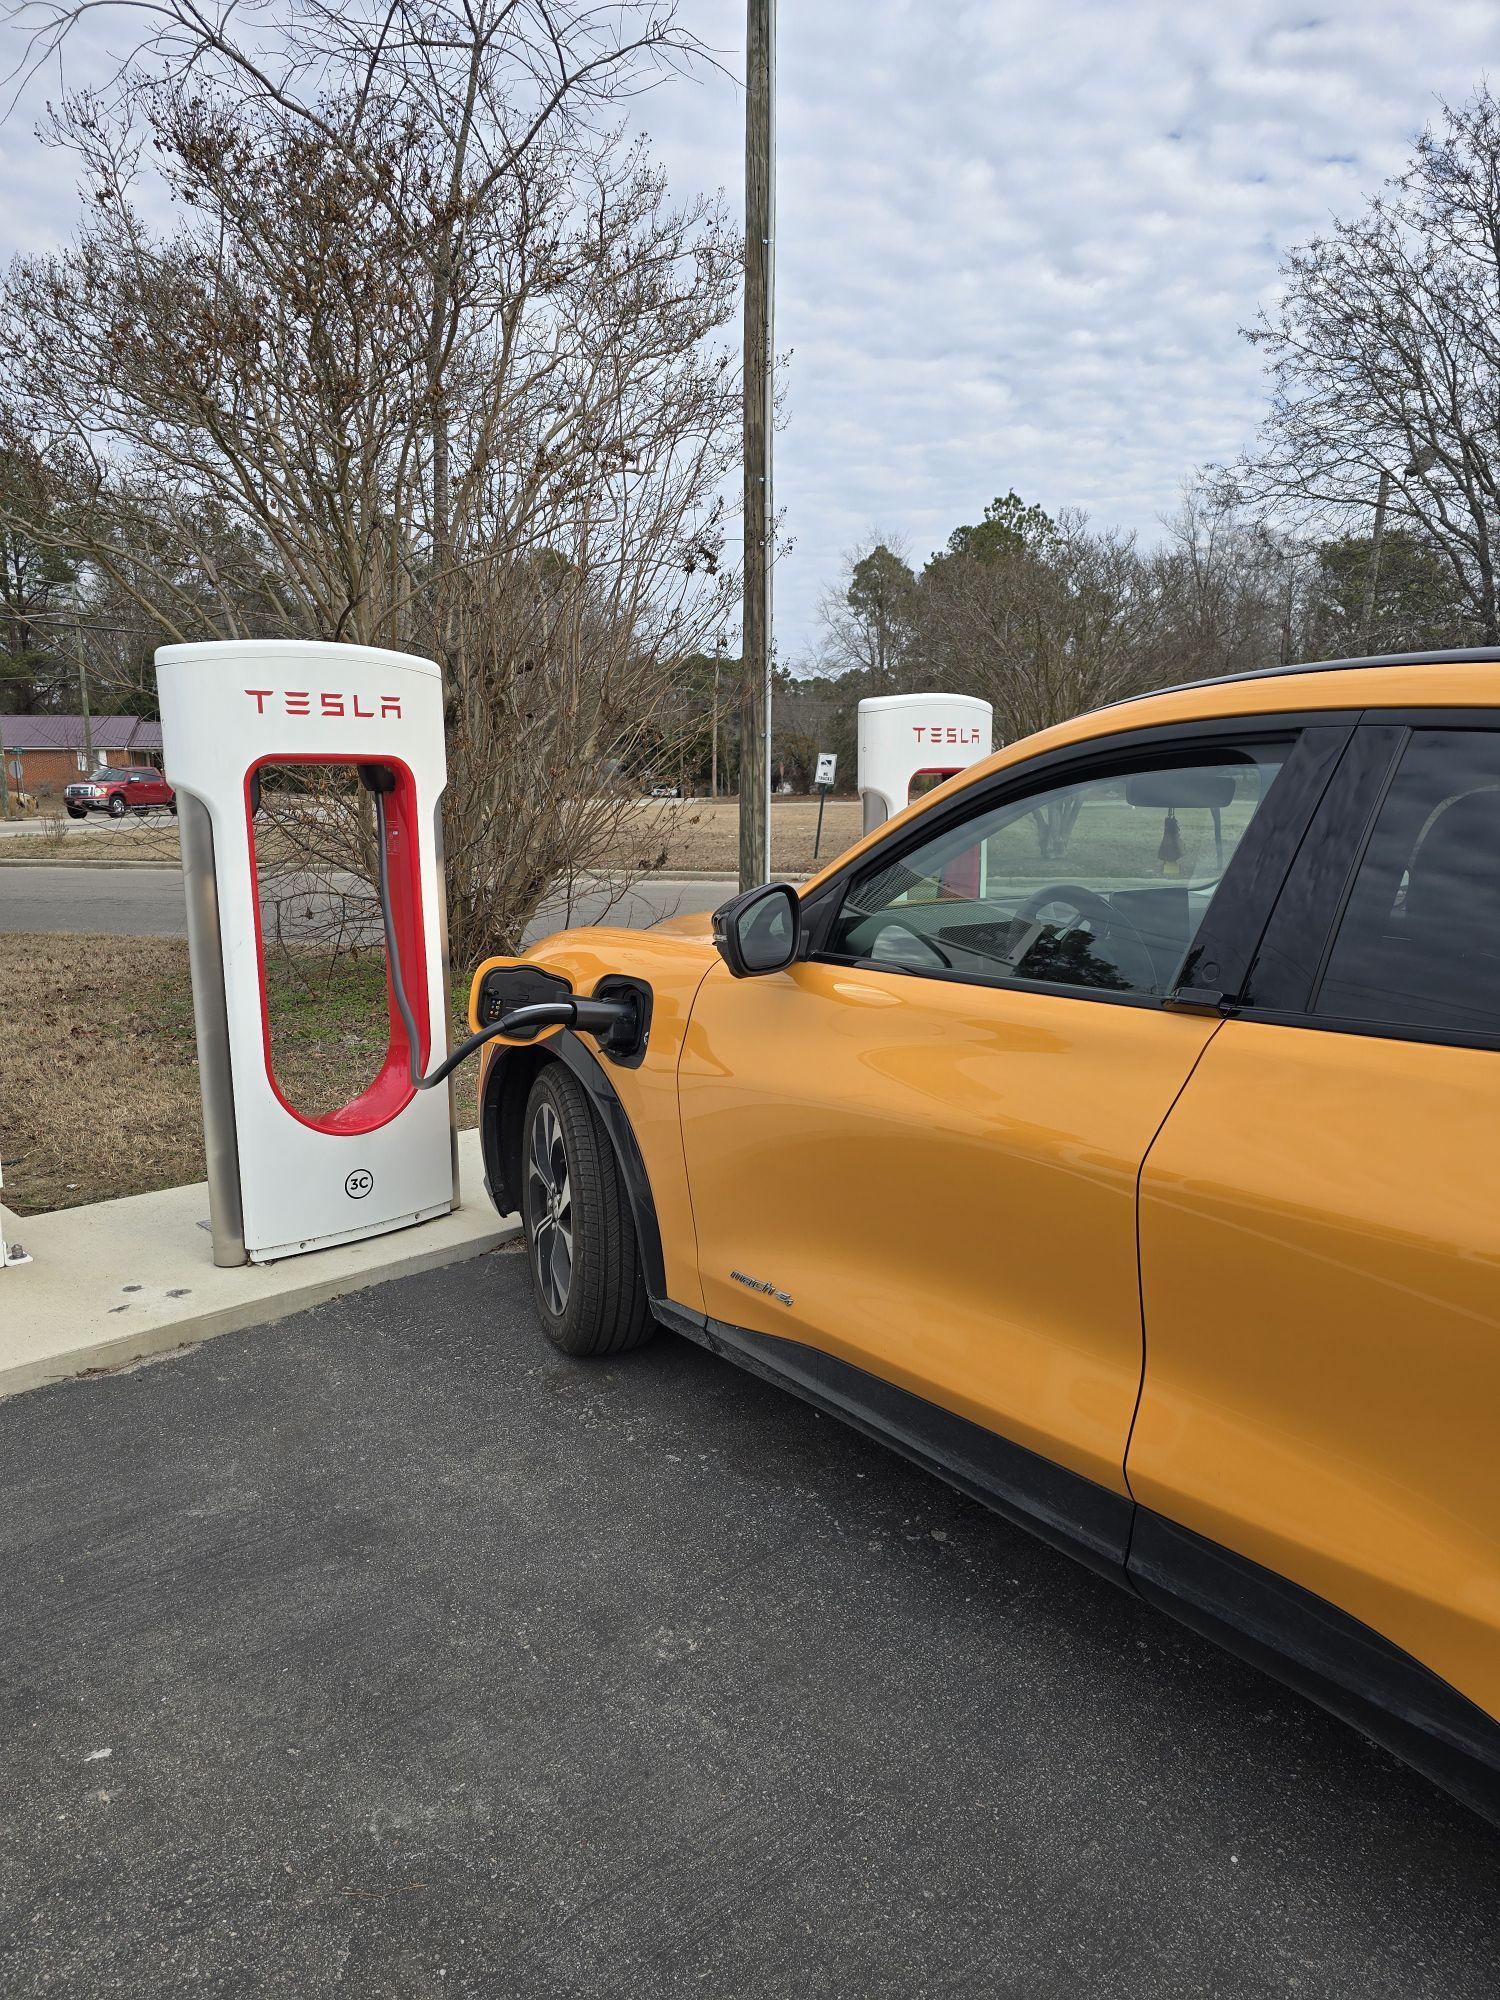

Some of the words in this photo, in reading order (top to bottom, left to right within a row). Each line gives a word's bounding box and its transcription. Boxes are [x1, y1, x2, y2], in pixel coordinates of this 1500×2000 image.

[244, 690, 401, 719] TESLA
[912, 727, 979, 743] TESLA
[350, 1176, 369, 1190] 3C
